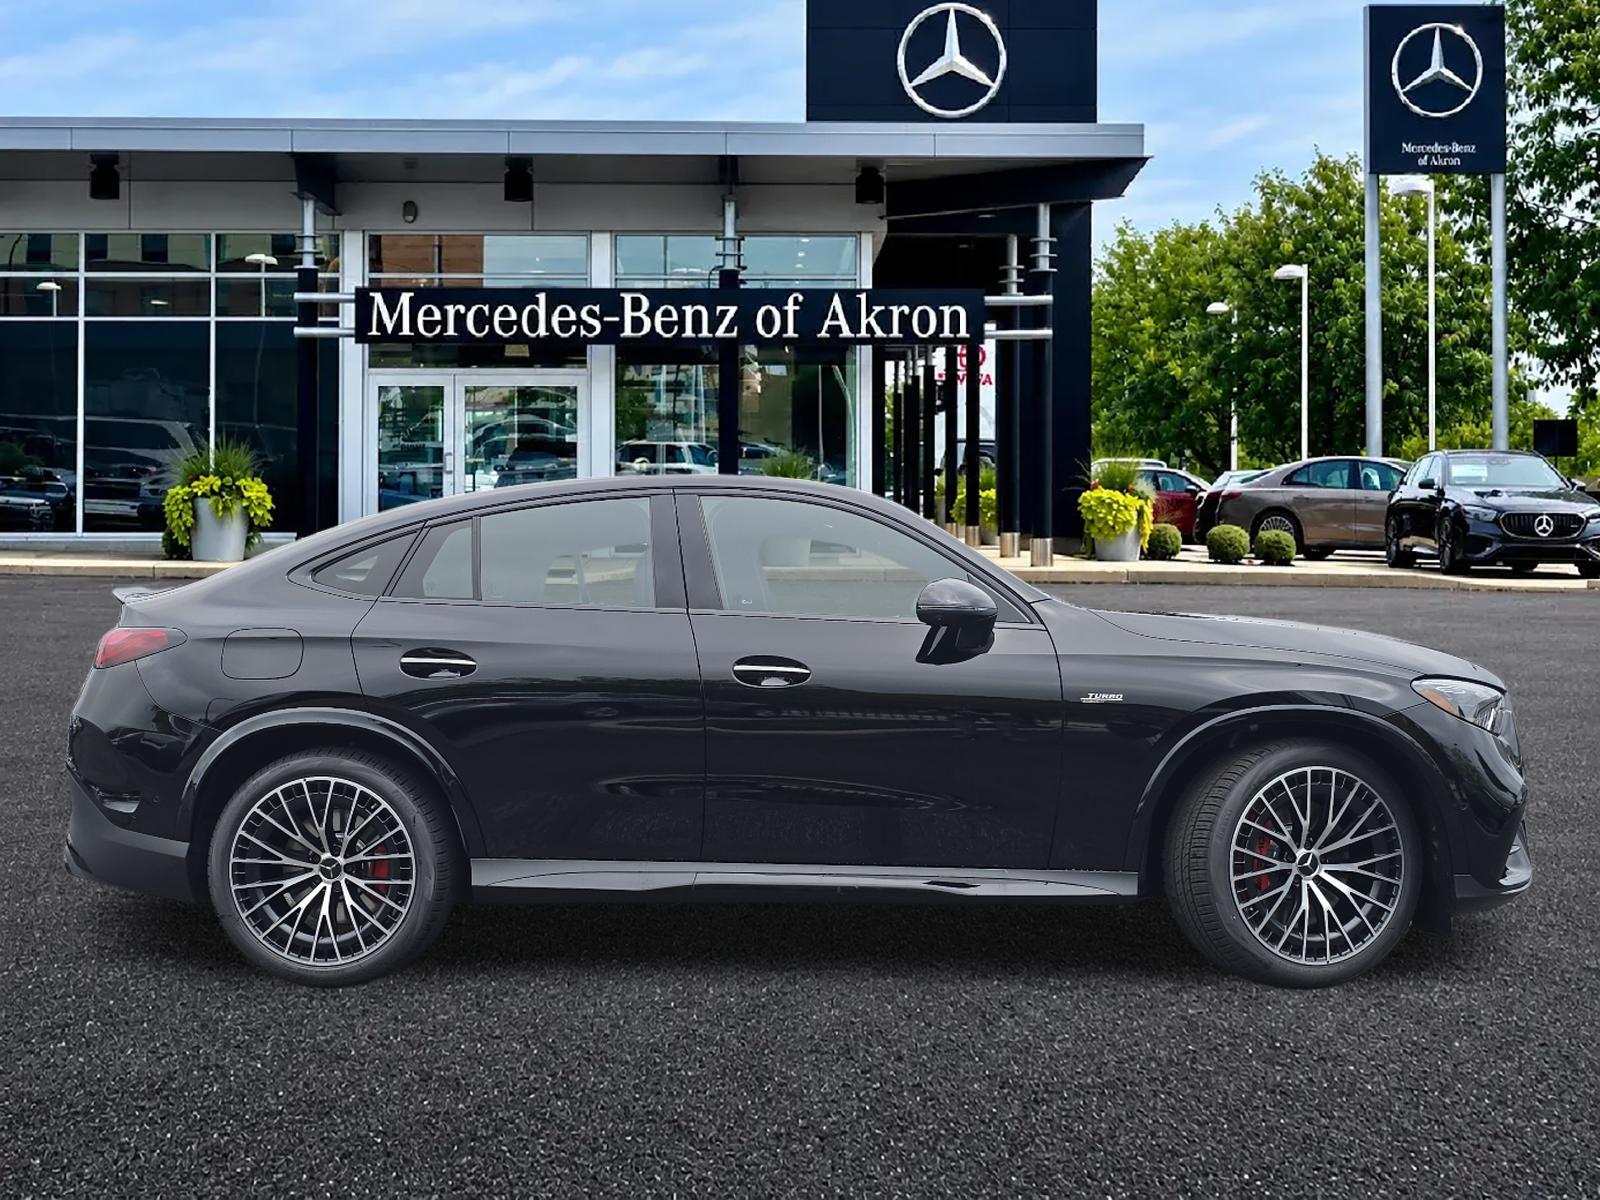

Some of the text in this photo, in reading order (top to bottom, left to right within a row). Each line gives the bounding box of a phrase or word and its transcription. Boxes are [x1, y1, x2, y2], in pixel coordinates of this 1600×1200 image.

[1417, 154, 1460, 165] of Akron
[367, 291, 970, 339] Mercedes-Benz of Akron
